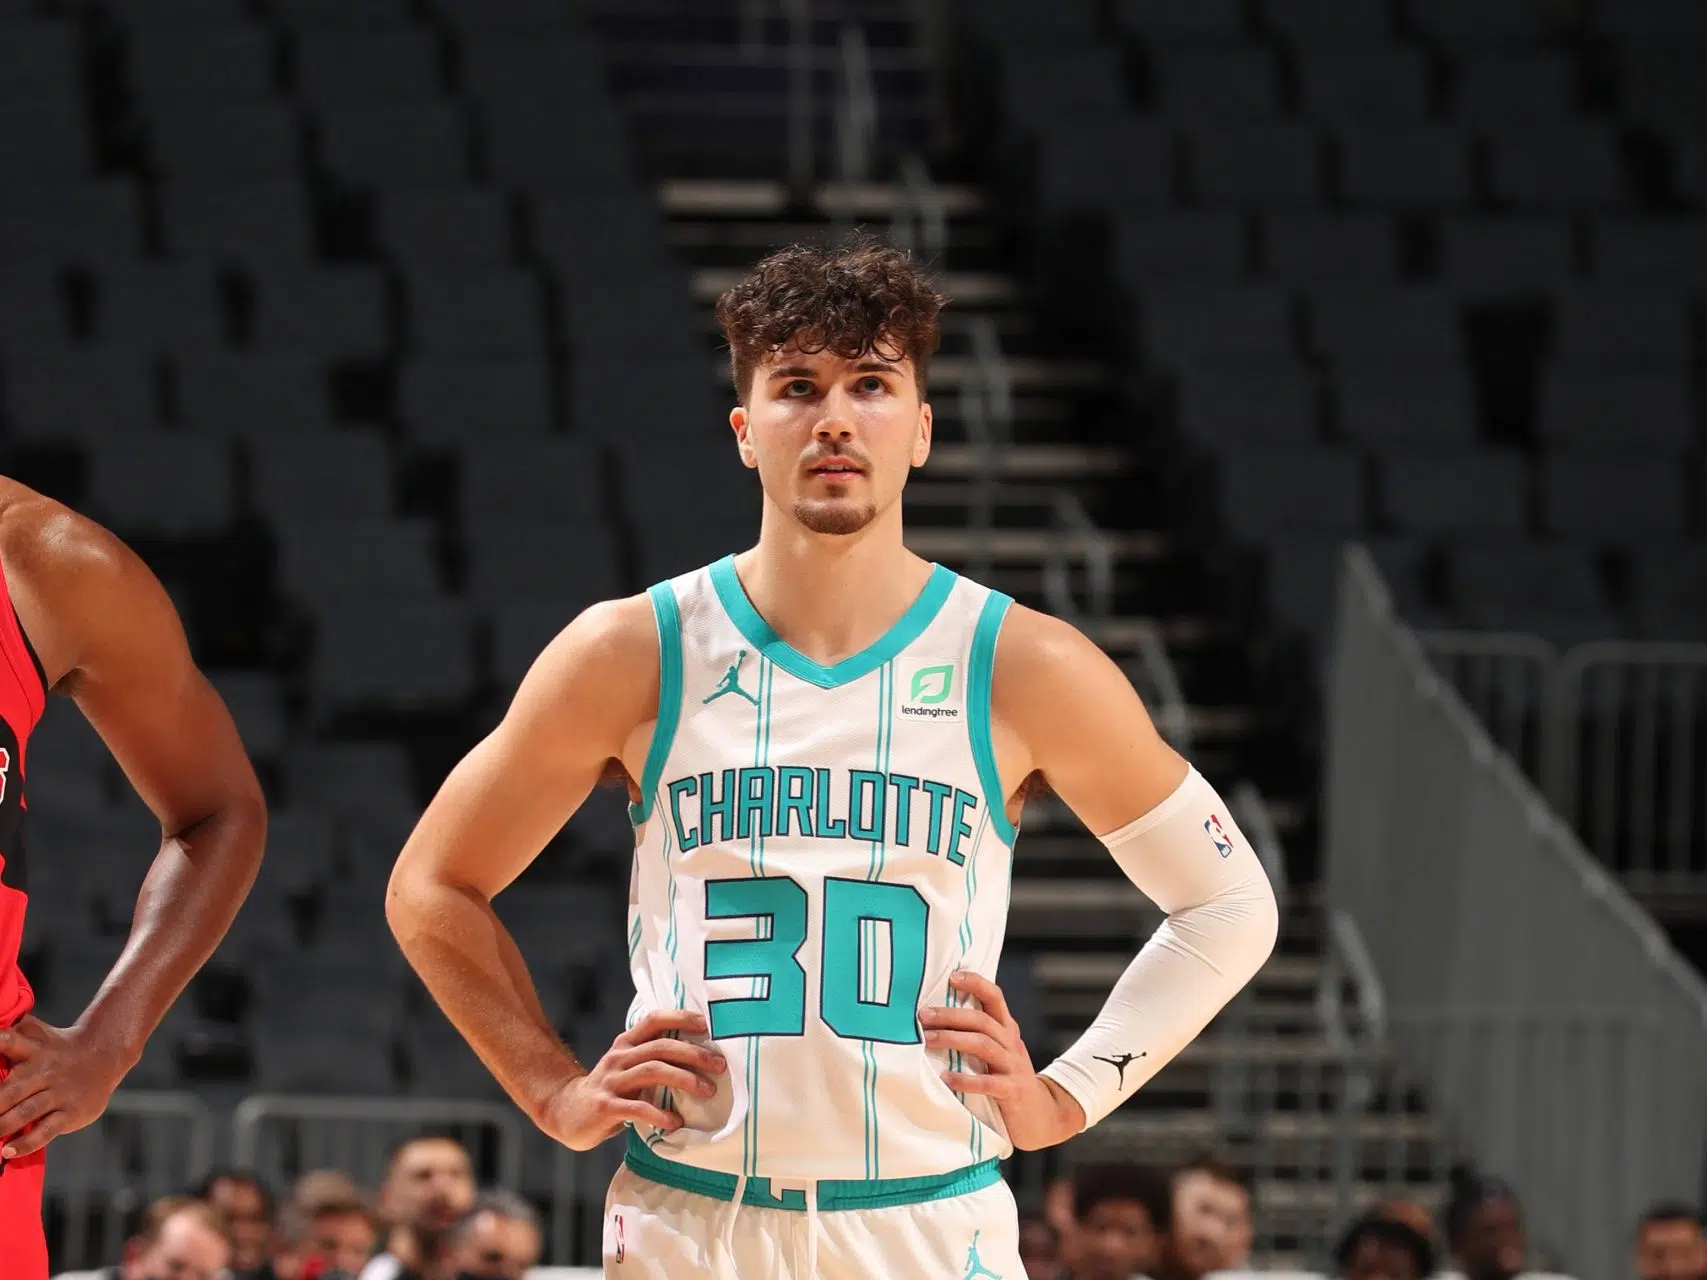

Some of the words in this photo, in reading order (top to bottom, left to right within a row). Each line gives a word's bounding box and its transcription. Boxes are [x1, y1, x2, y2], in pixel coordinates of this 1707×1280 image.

[901, 705, 958, 718] lendingtree
[668, 766, 978, 867] CHARLOTTE
[703, 875, 930, 1046] 30
